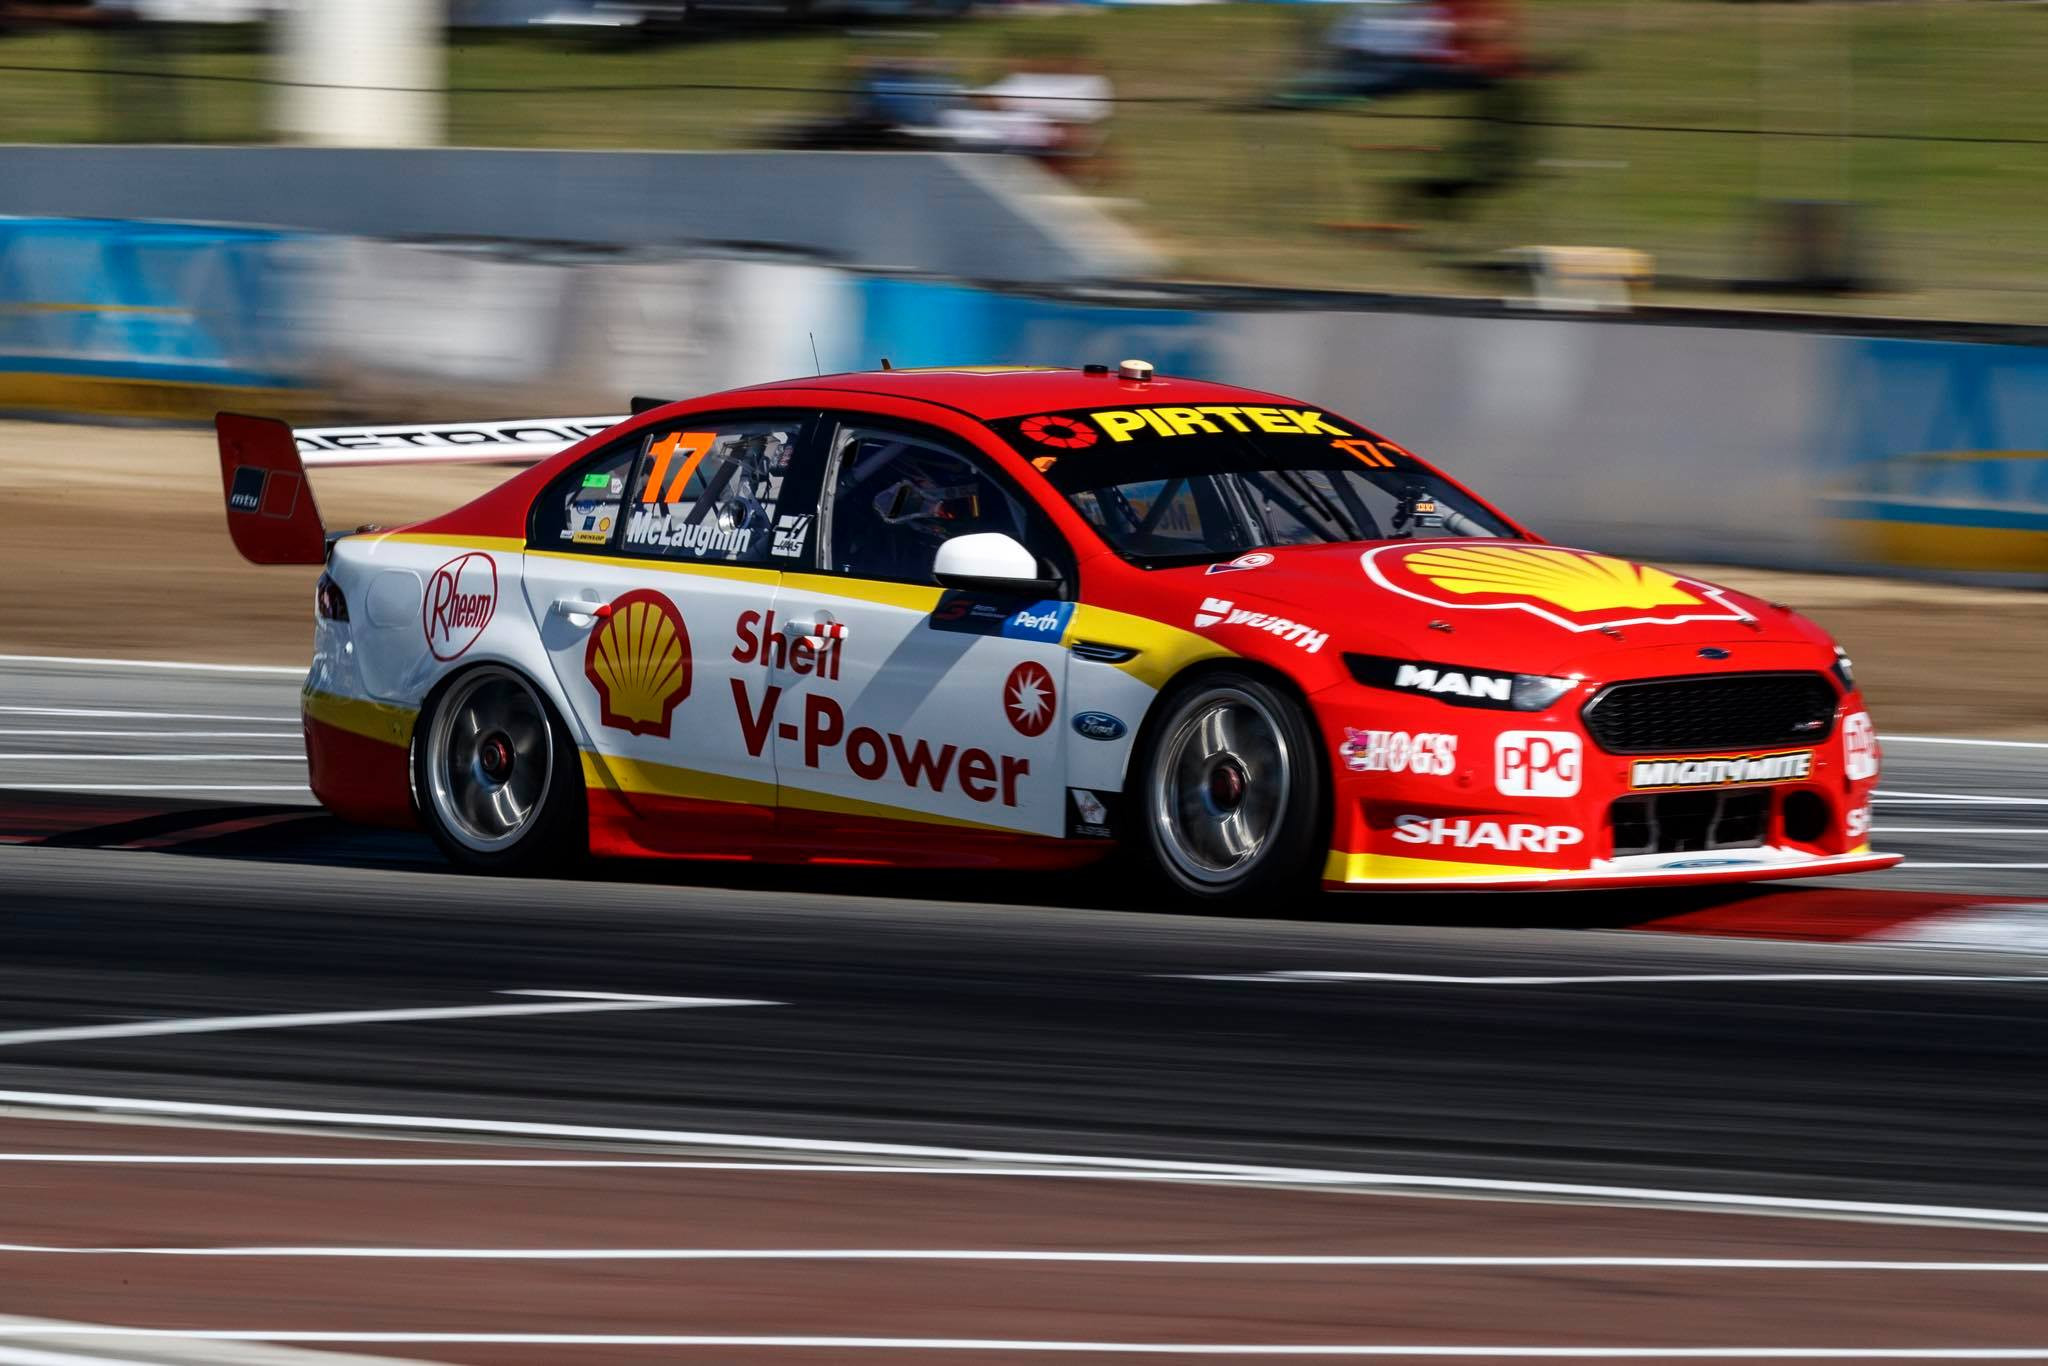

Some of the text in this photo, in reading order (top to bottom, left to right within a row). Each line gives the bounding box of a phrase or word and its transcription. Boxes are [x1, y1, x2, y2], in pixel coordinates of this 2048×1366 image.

[1090, 406, 1352, 442] PIRTEK
[641, 432, 717, 503] 17
[1329, 439, 1396, 468] 17
[230, 493, 258, 507] mtu
[430, 556, 492, 642] Rheem
[1013, 610, 1058, 632] Perth
[1395, 664, 1513, 701] MAN
[729, 677, 1030, 807] V-Power
[1364, 730, 1458, 776] HOGS
[1502, 736, 1577, 790] PPG
[1391, 813, 1585, 853] SHARP
